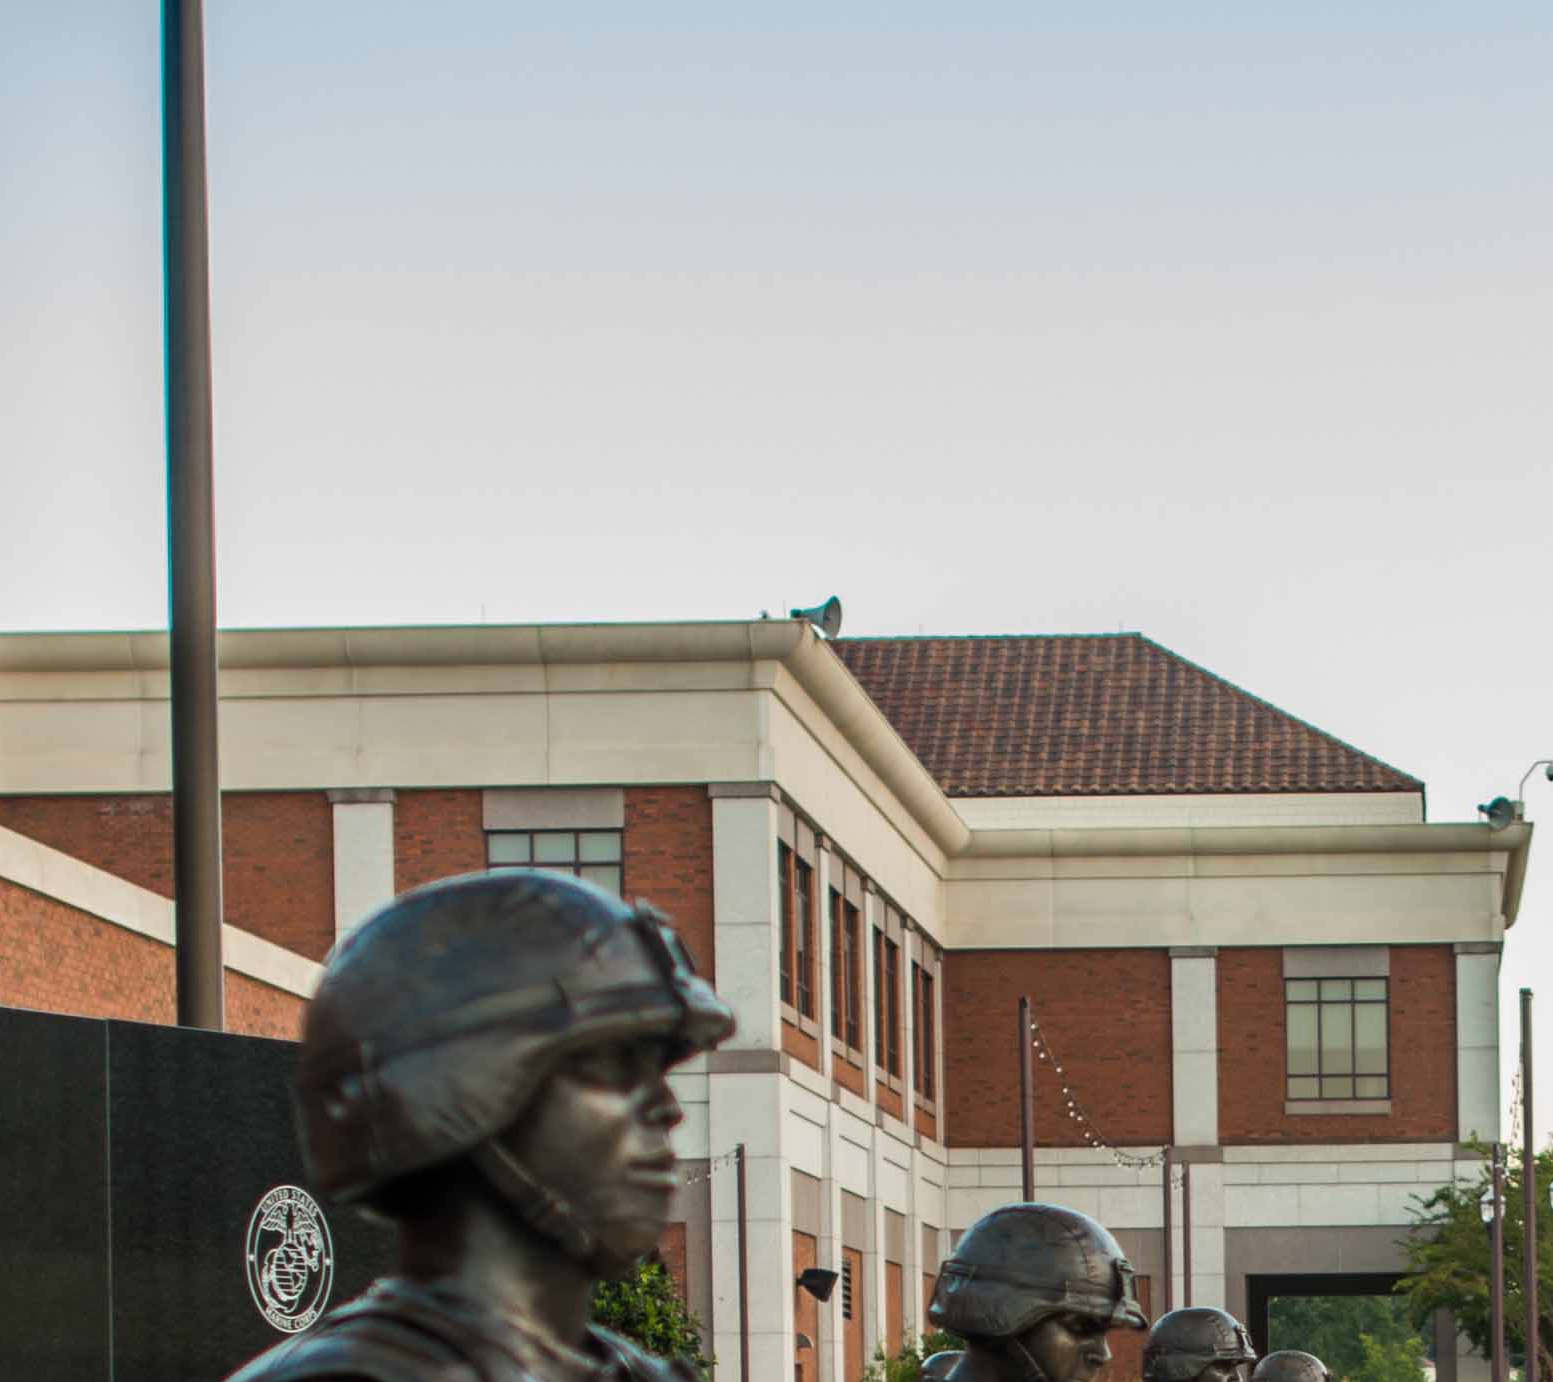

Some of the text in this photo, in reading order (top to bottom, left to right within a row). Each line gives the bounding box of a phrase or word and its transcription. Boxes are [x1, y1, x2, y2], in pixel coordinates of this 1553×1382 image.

[261, 1190, 317, 1217] UNITED STATES
[266, 1308, 317, 1329] MARINE CORPS
